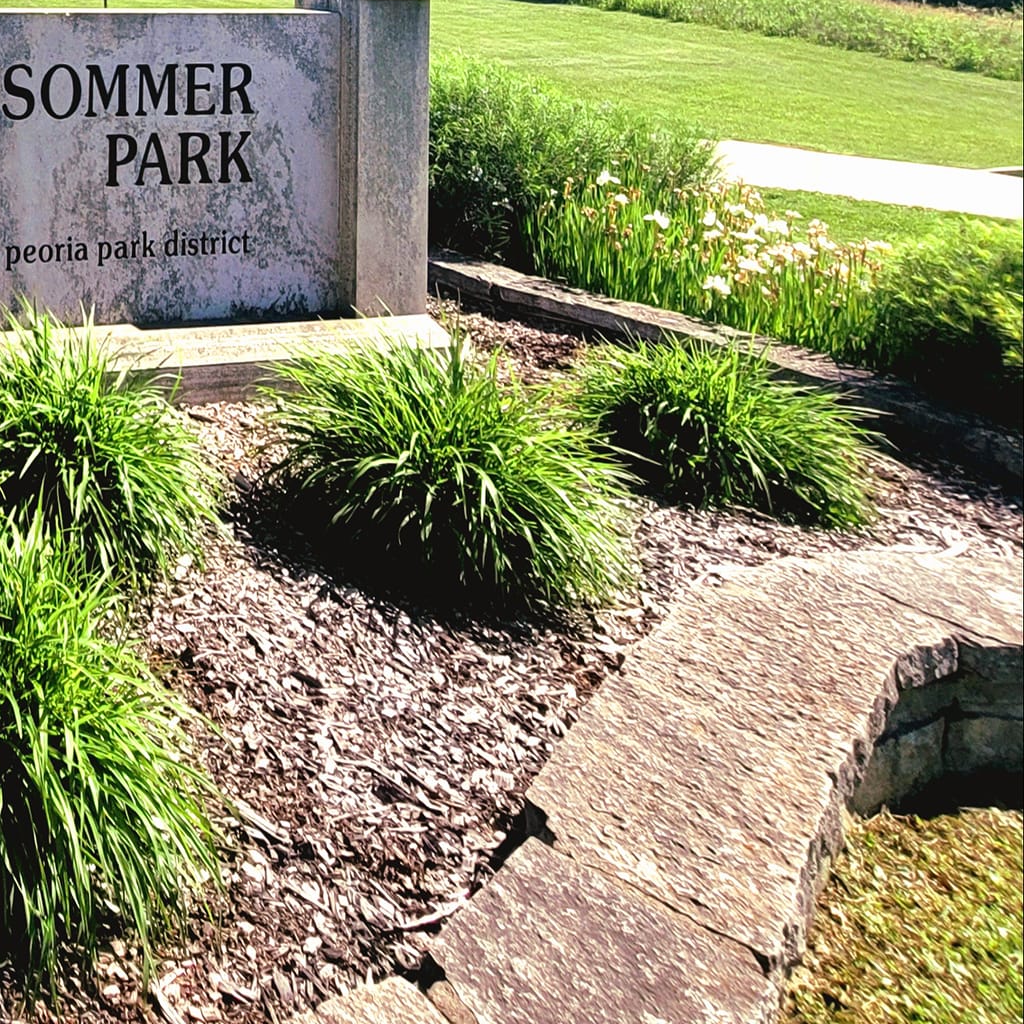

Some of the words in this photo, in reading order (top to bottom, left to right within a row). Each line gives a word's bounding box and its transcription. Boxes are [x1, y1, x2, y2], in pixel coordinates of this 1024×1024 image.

[1, 62, 254, 121] SOMMER
[105, 130, 253, 187] PARK
[5, 236, 89, 270] peoria
[97, 230, 156, 266] park
[163, 229, 252, 257] district
